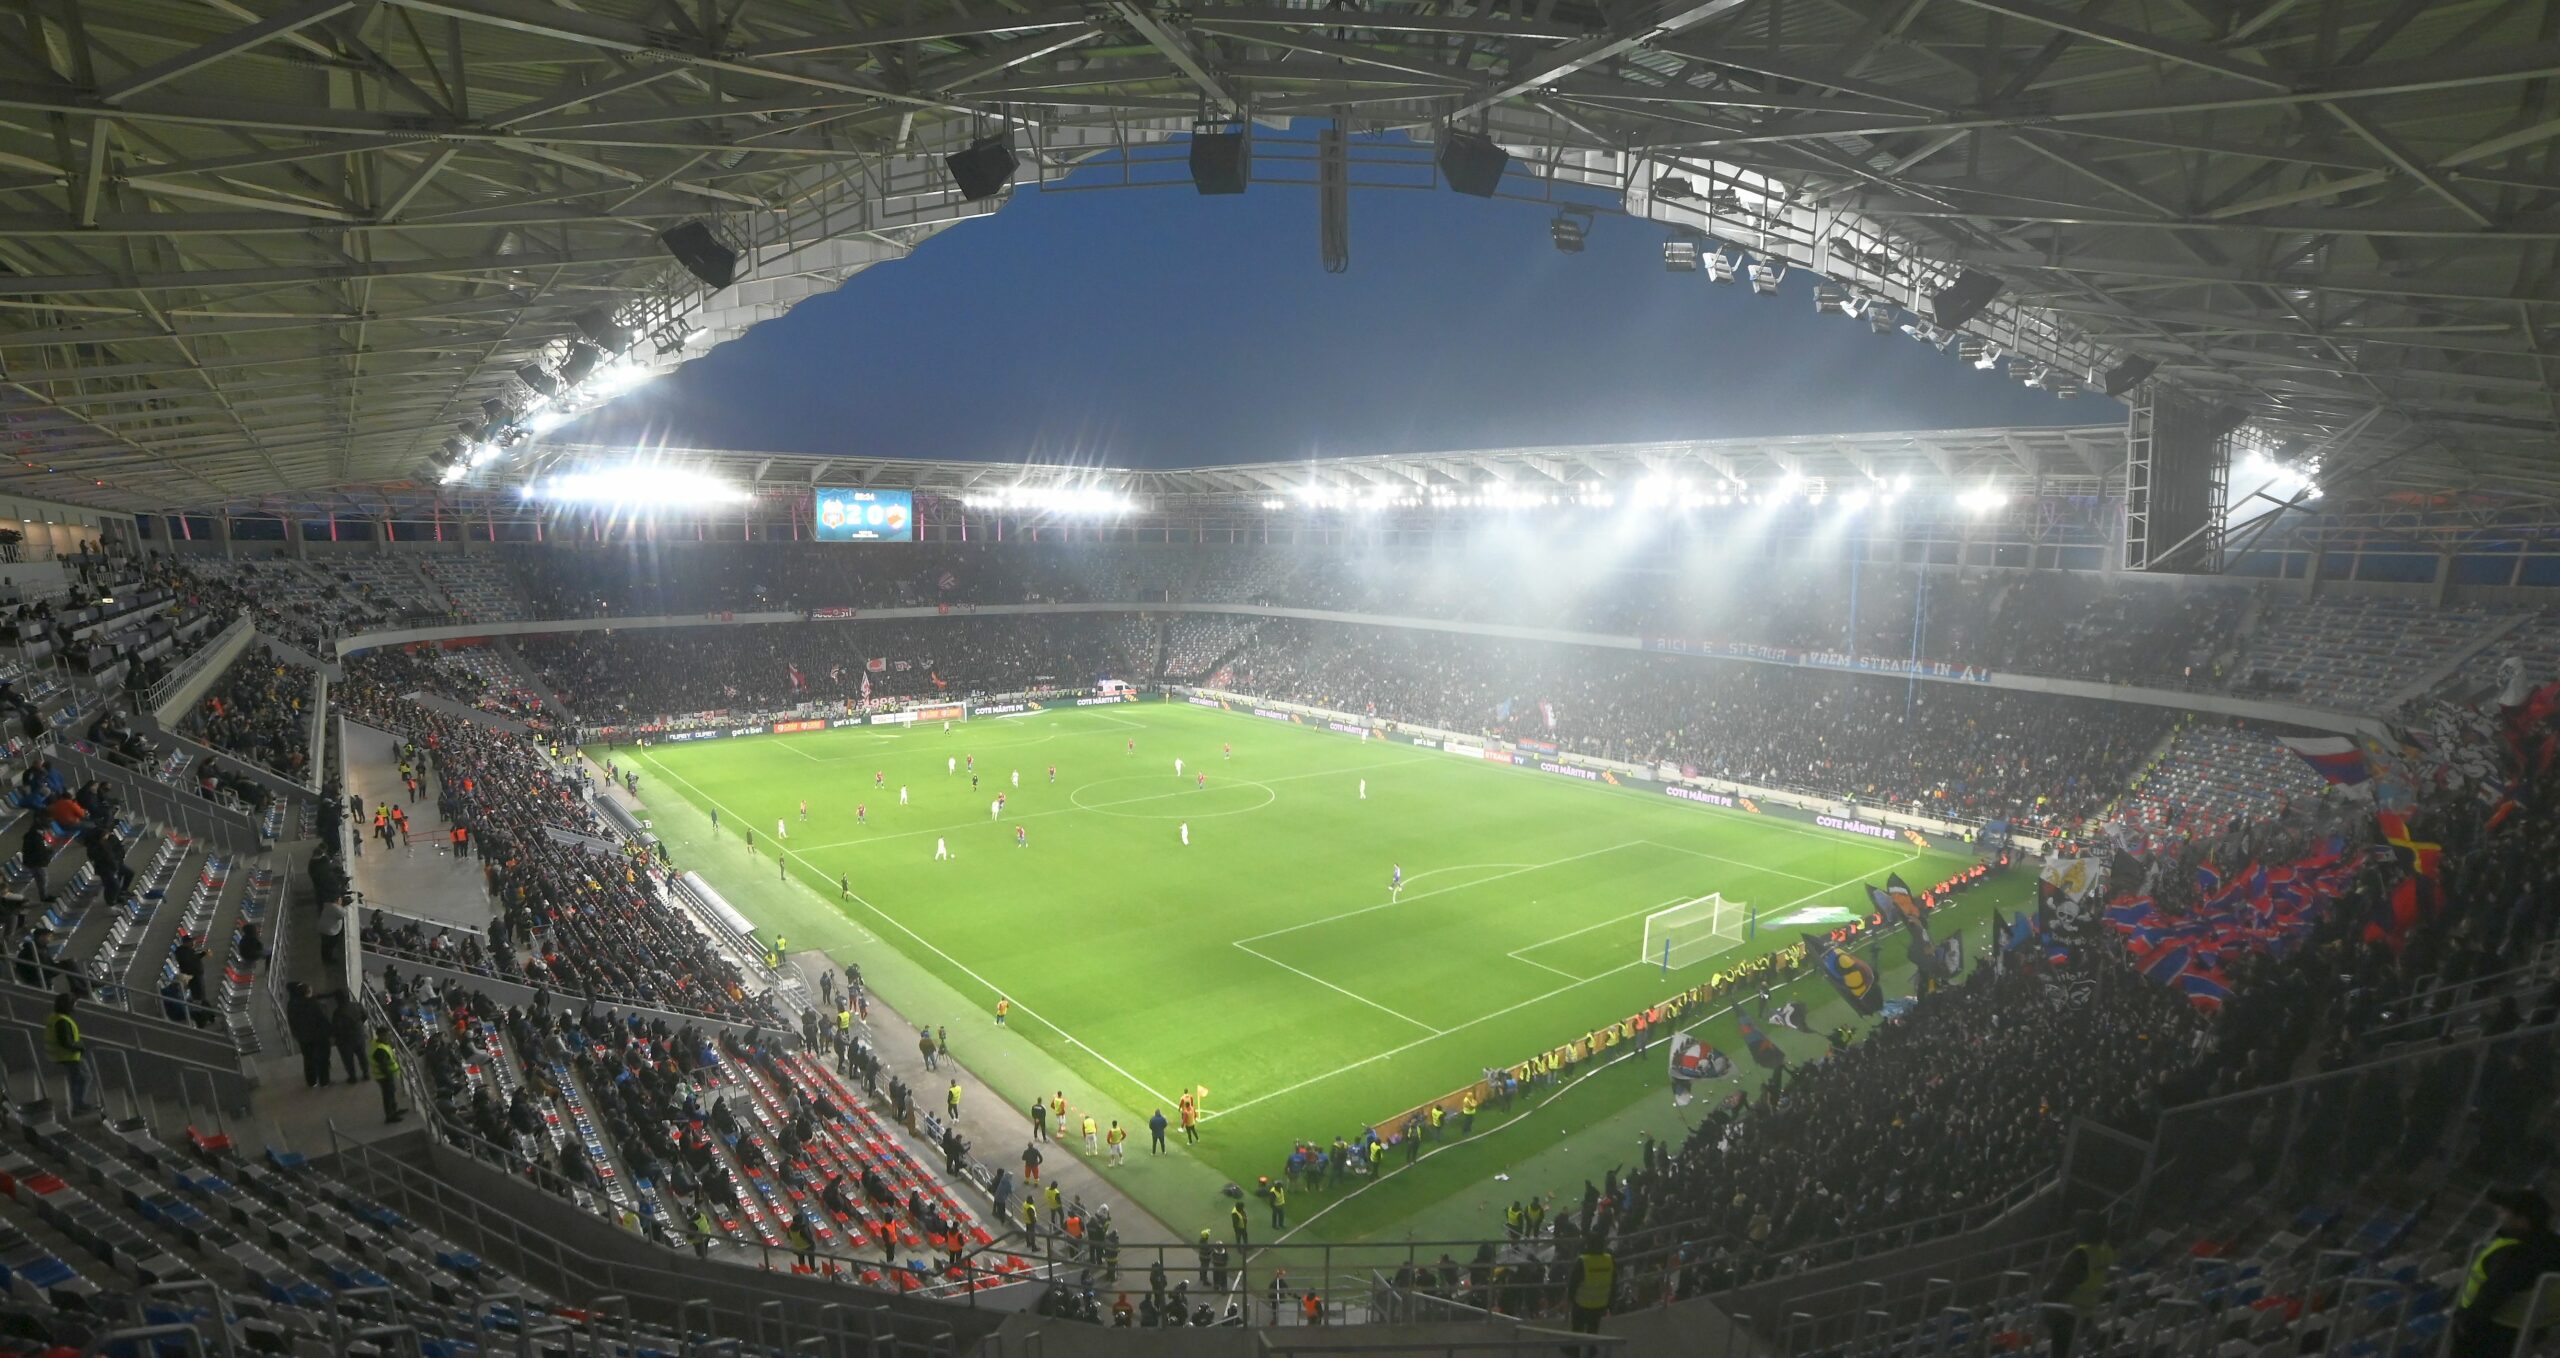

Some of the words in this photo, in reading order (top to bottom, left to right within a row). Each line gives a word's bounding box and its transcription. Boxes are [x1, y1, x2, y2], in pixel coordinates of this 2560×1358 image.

[846, 504, 862, 525] 2
[867, 504, 884, 525] 0
[1703, 641, 1713, 653] E
[1933, 662, 1952, 676] IN
[1514, 756, 1524, 765] TV
[1541, 762, 1559, 773] COTE
[1586, 771, 1596, 780] PE
[1666, 786, 1688, 799] COTE
[1720, 797, 1732, 807] PE
[1816, 815, 1843, 829] COTE
[1882, 828, 1896, 840] PE
